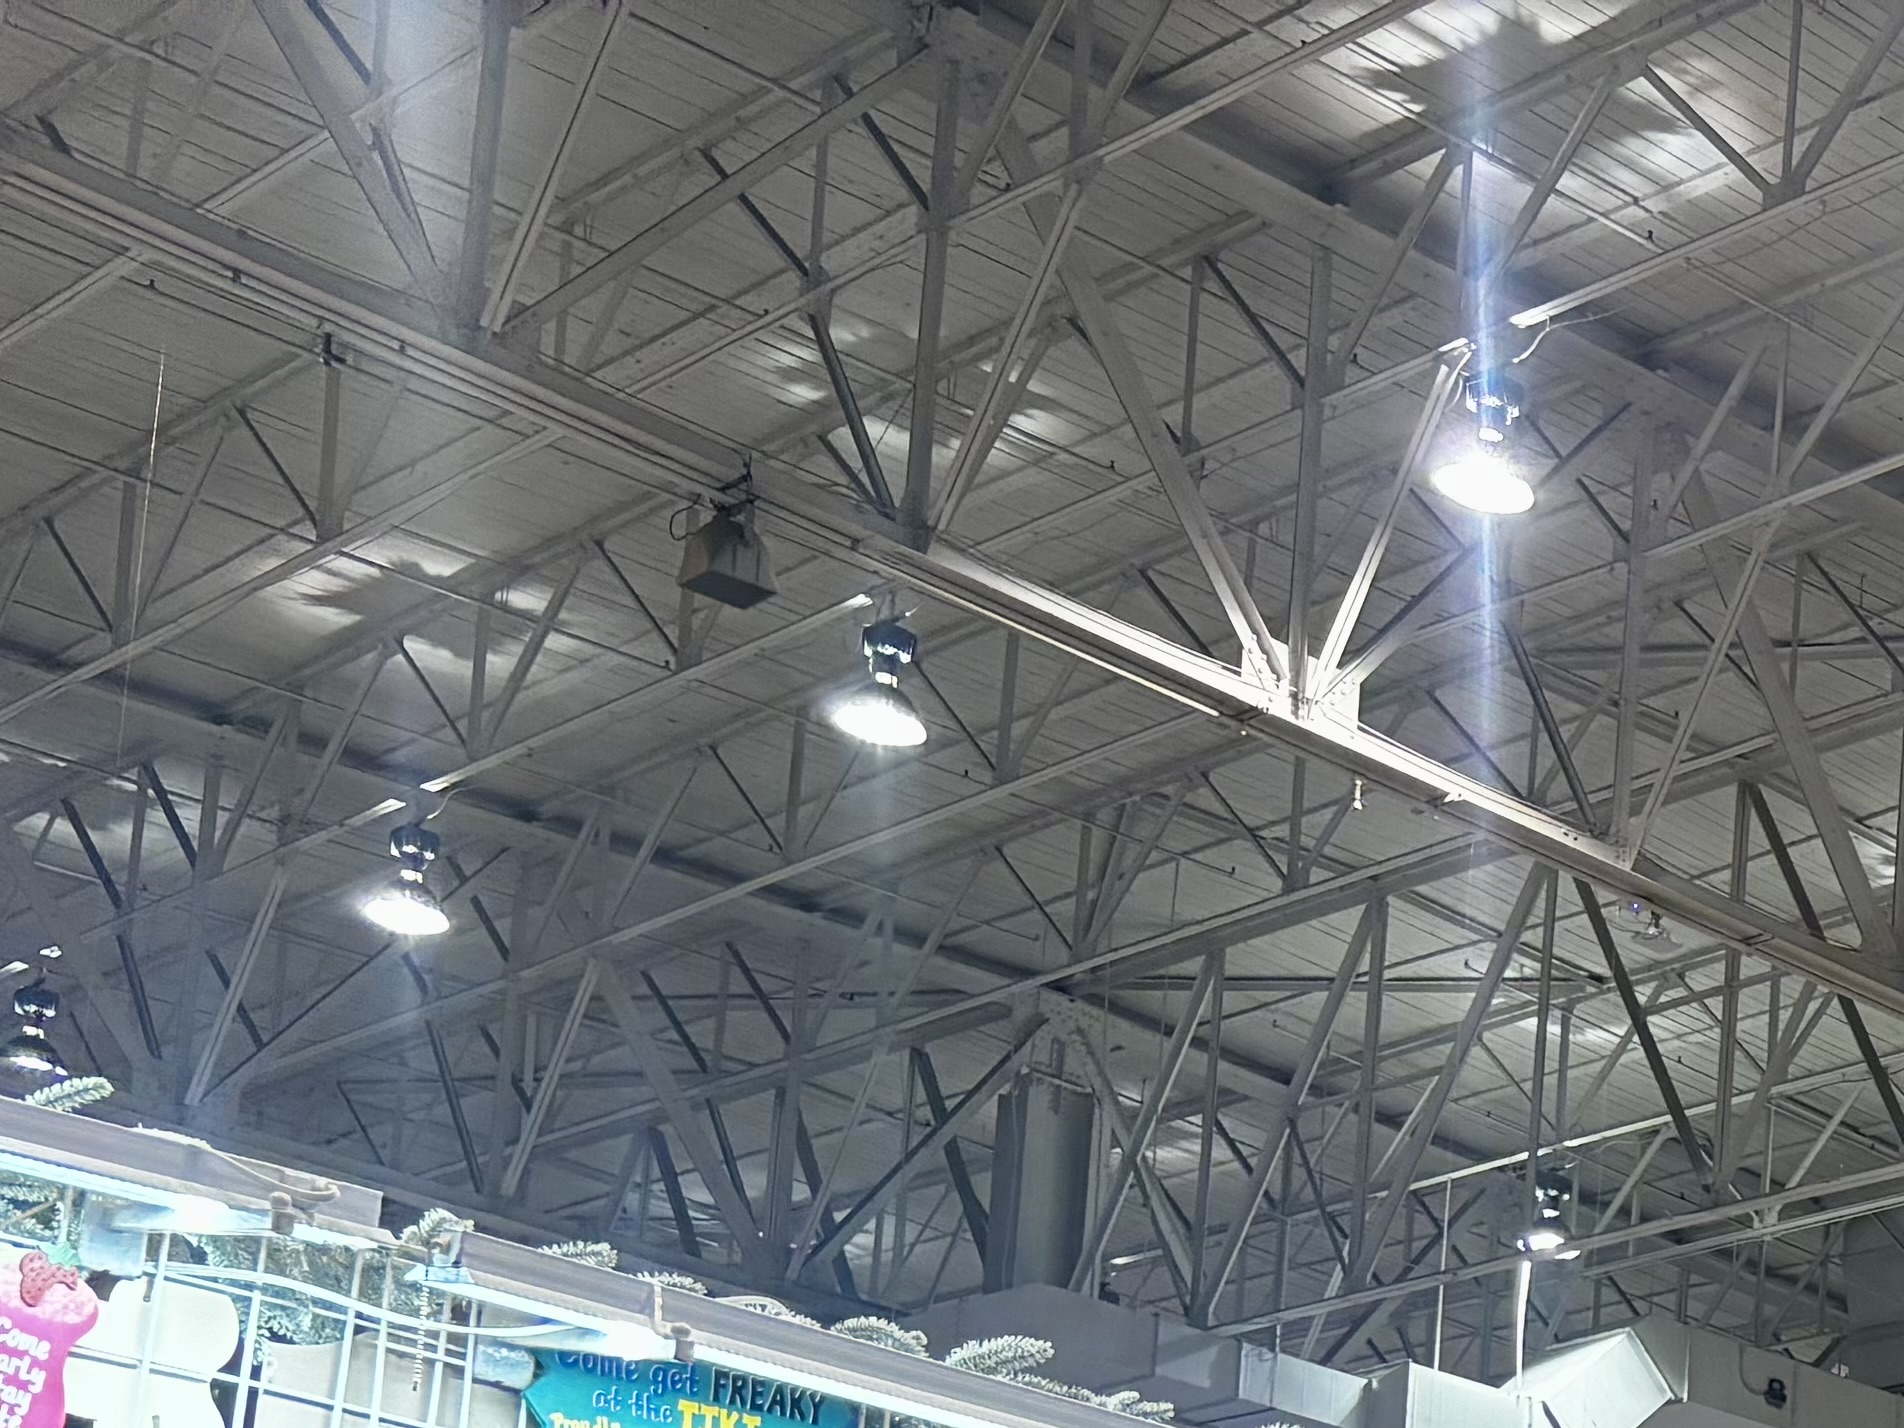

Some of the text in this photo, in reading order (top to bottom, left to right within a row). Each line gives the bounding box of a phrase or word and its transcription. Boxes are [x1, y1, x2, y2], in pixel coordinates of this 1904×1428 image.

[594, 1387, 623, 1411] at
[632, 1392, 674, 1422] the
[651, 1364, 823, 1426] get FREAKY
